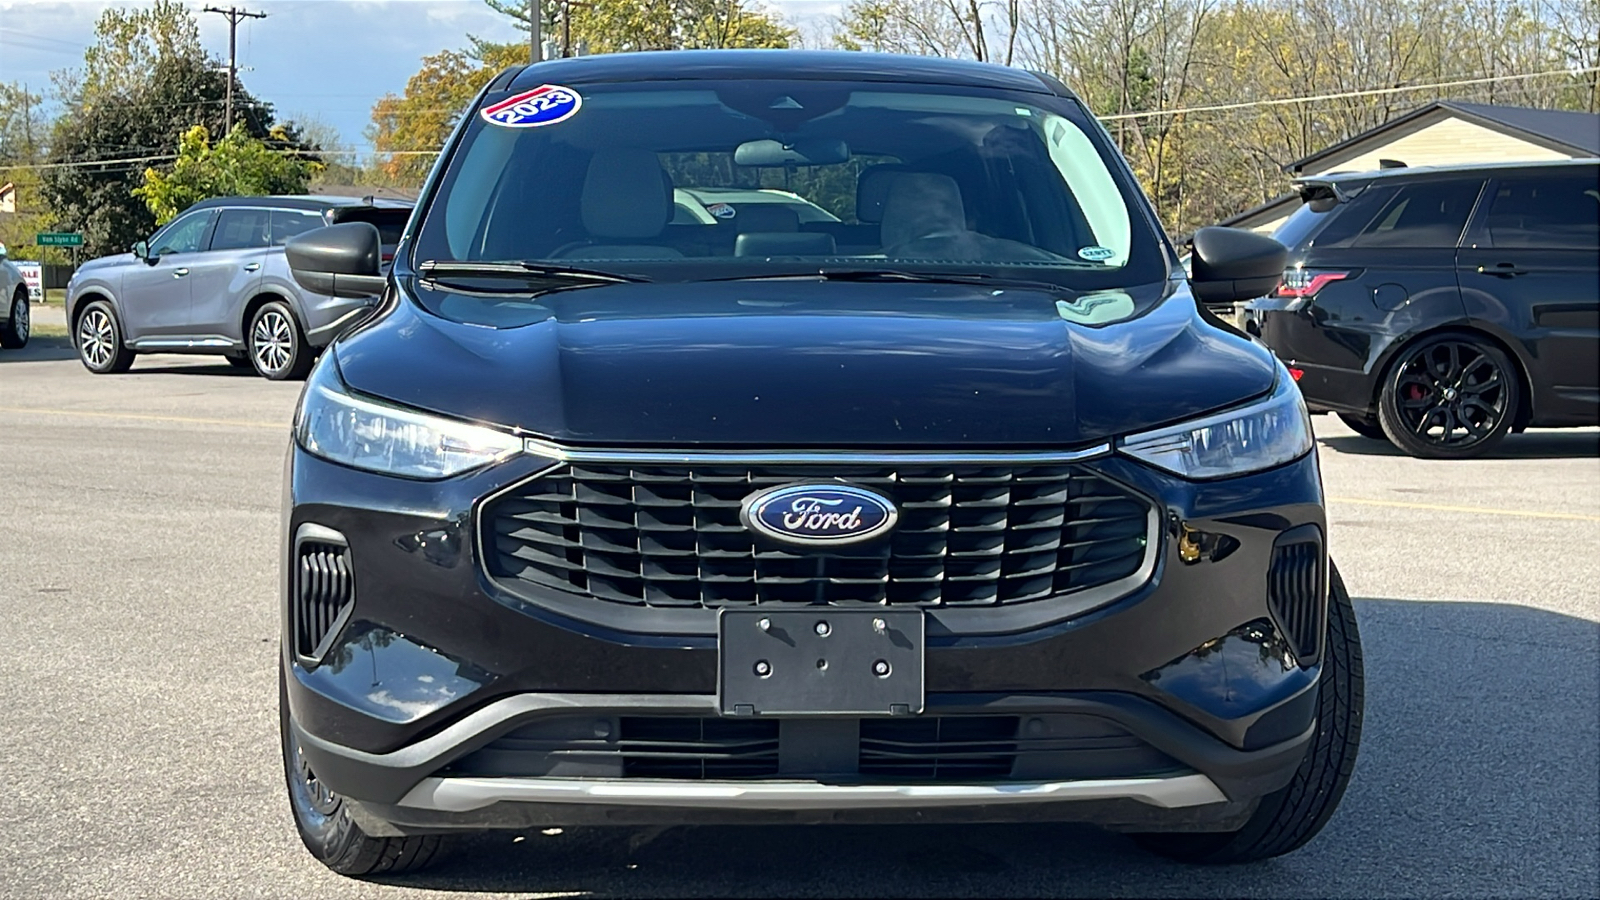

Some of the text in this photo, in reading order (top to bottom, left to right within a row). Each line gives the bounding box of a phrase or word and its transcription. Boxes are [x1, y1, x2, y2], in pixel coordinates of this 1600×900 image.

[496, 91, 573, 124] 2023
[21, 270, 39, 278] ALE
[783, 497, 862, 530] Ford
